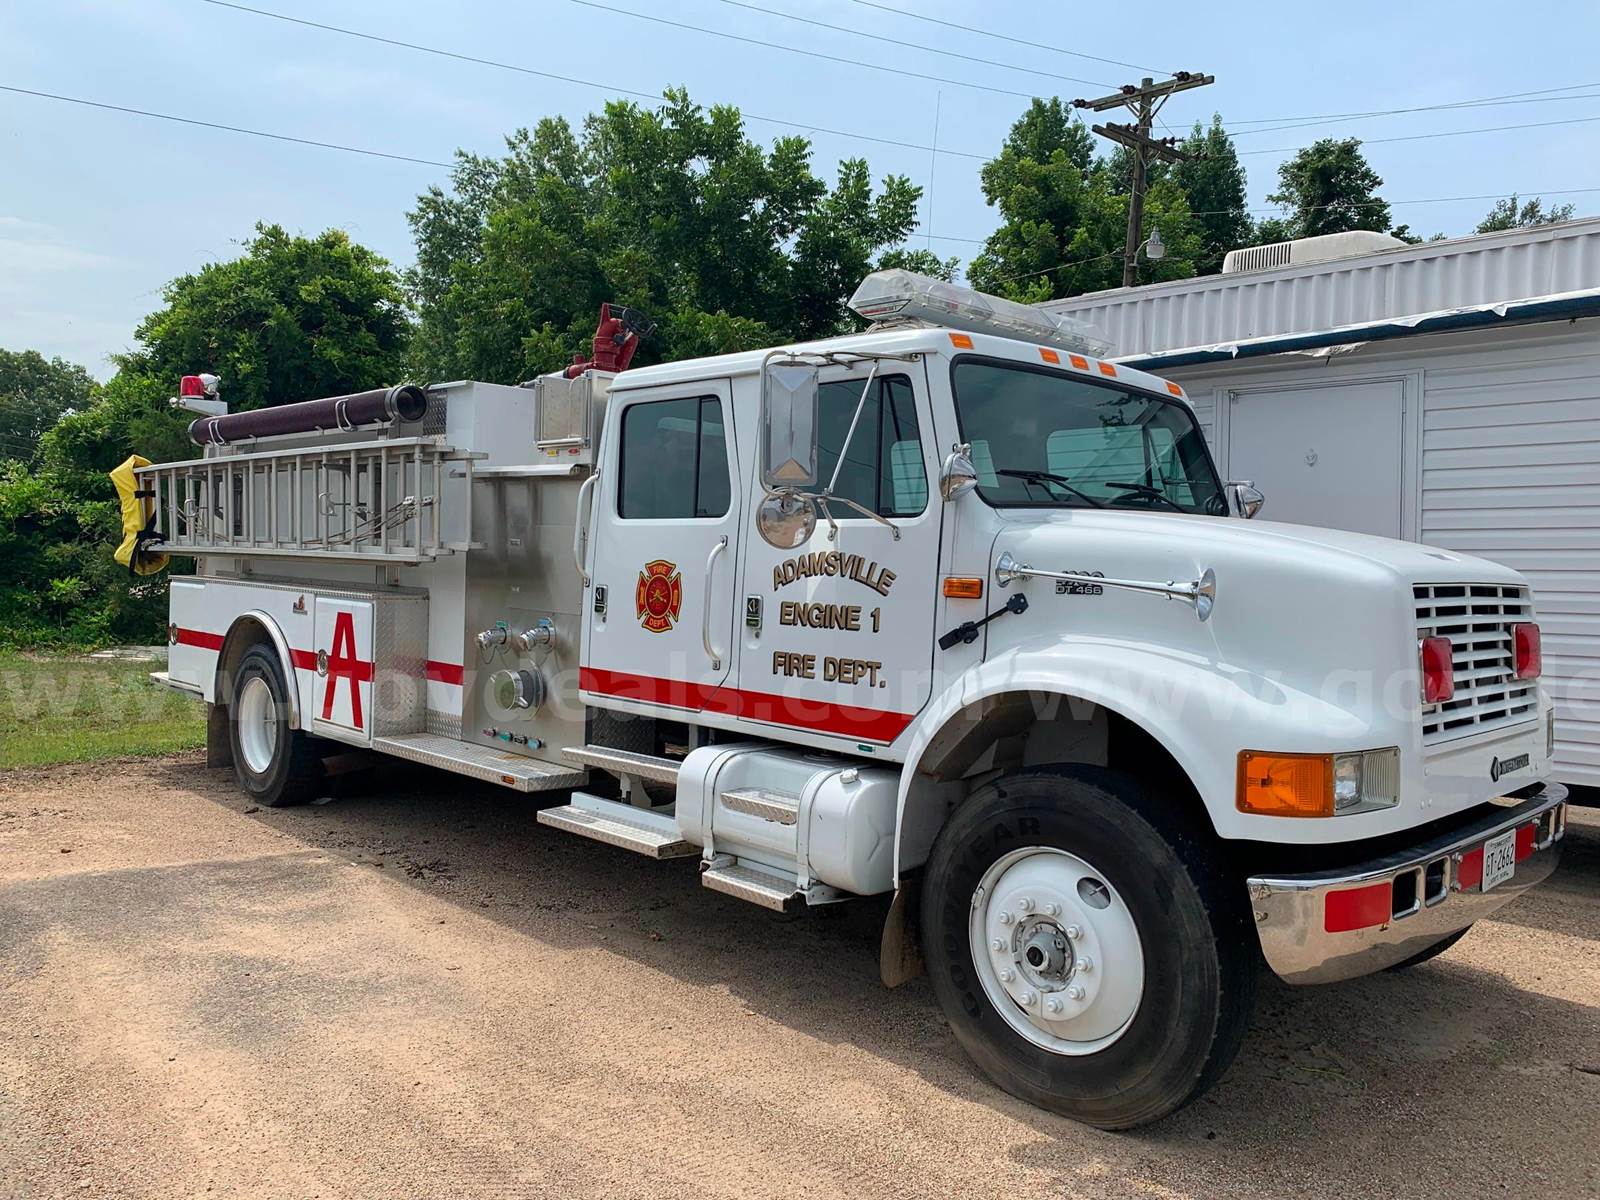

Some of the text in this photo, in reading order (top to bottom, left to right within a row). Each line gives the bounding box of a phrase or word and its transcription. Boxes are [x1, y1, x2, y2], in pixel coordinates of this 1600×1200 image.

[653, 565, 668, 574] FIRE
[773, 551, 897, 597] ADAMSVILLE
[1056, 585, 1102, 595] DT 466
[779, 601, 881, 633] ENGINE 1
[773, 651, 887, 688] FIRE DEPT.
